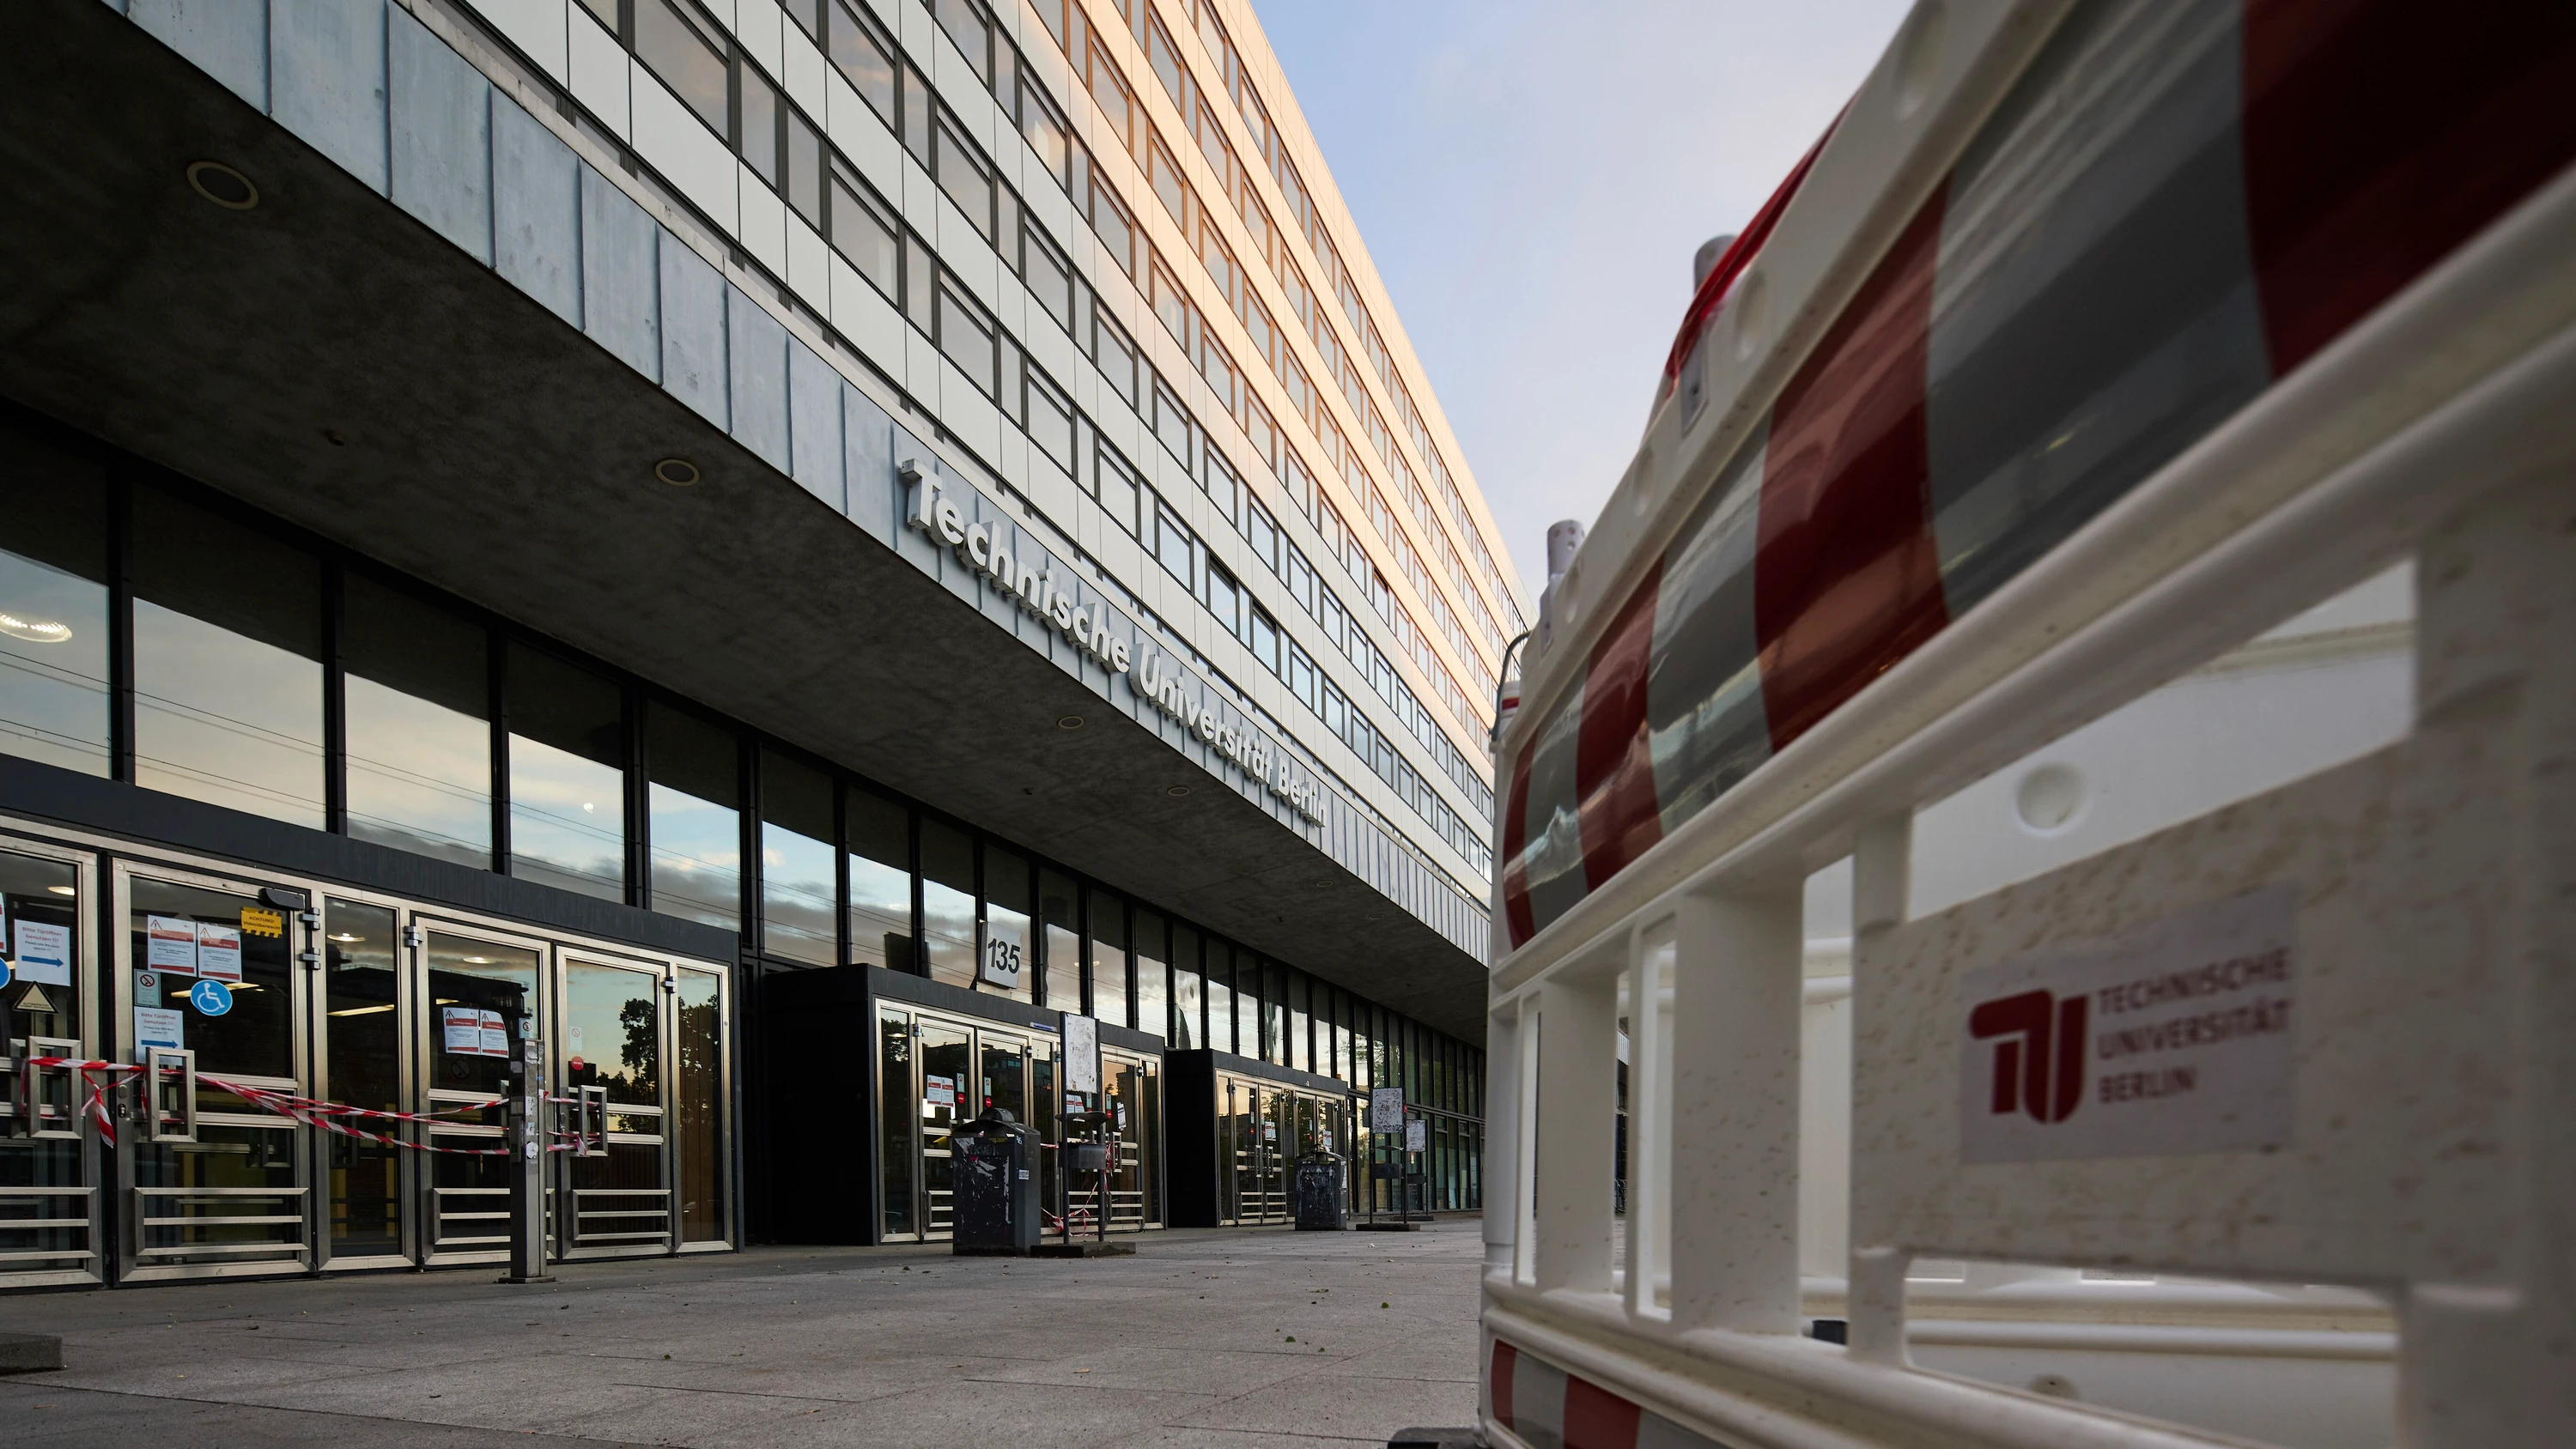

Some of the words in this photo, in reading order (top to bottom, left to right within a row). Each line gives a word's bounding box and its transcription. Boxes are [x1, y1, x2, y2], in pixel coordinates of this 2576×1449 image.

[902, 458, 1130, 674] Technische
[1129, 643, 1273, 785] Universität
[1270, 756, 1327, 828] Berlin
[988, 938, 1020, 973] 135
[2099, 948, 2292, 1015] TECHNISCHE
[2098, 997, 2293, 1060] UNIVERSITÄT
[2098, 1066, 2196, 1104] BERLIN
